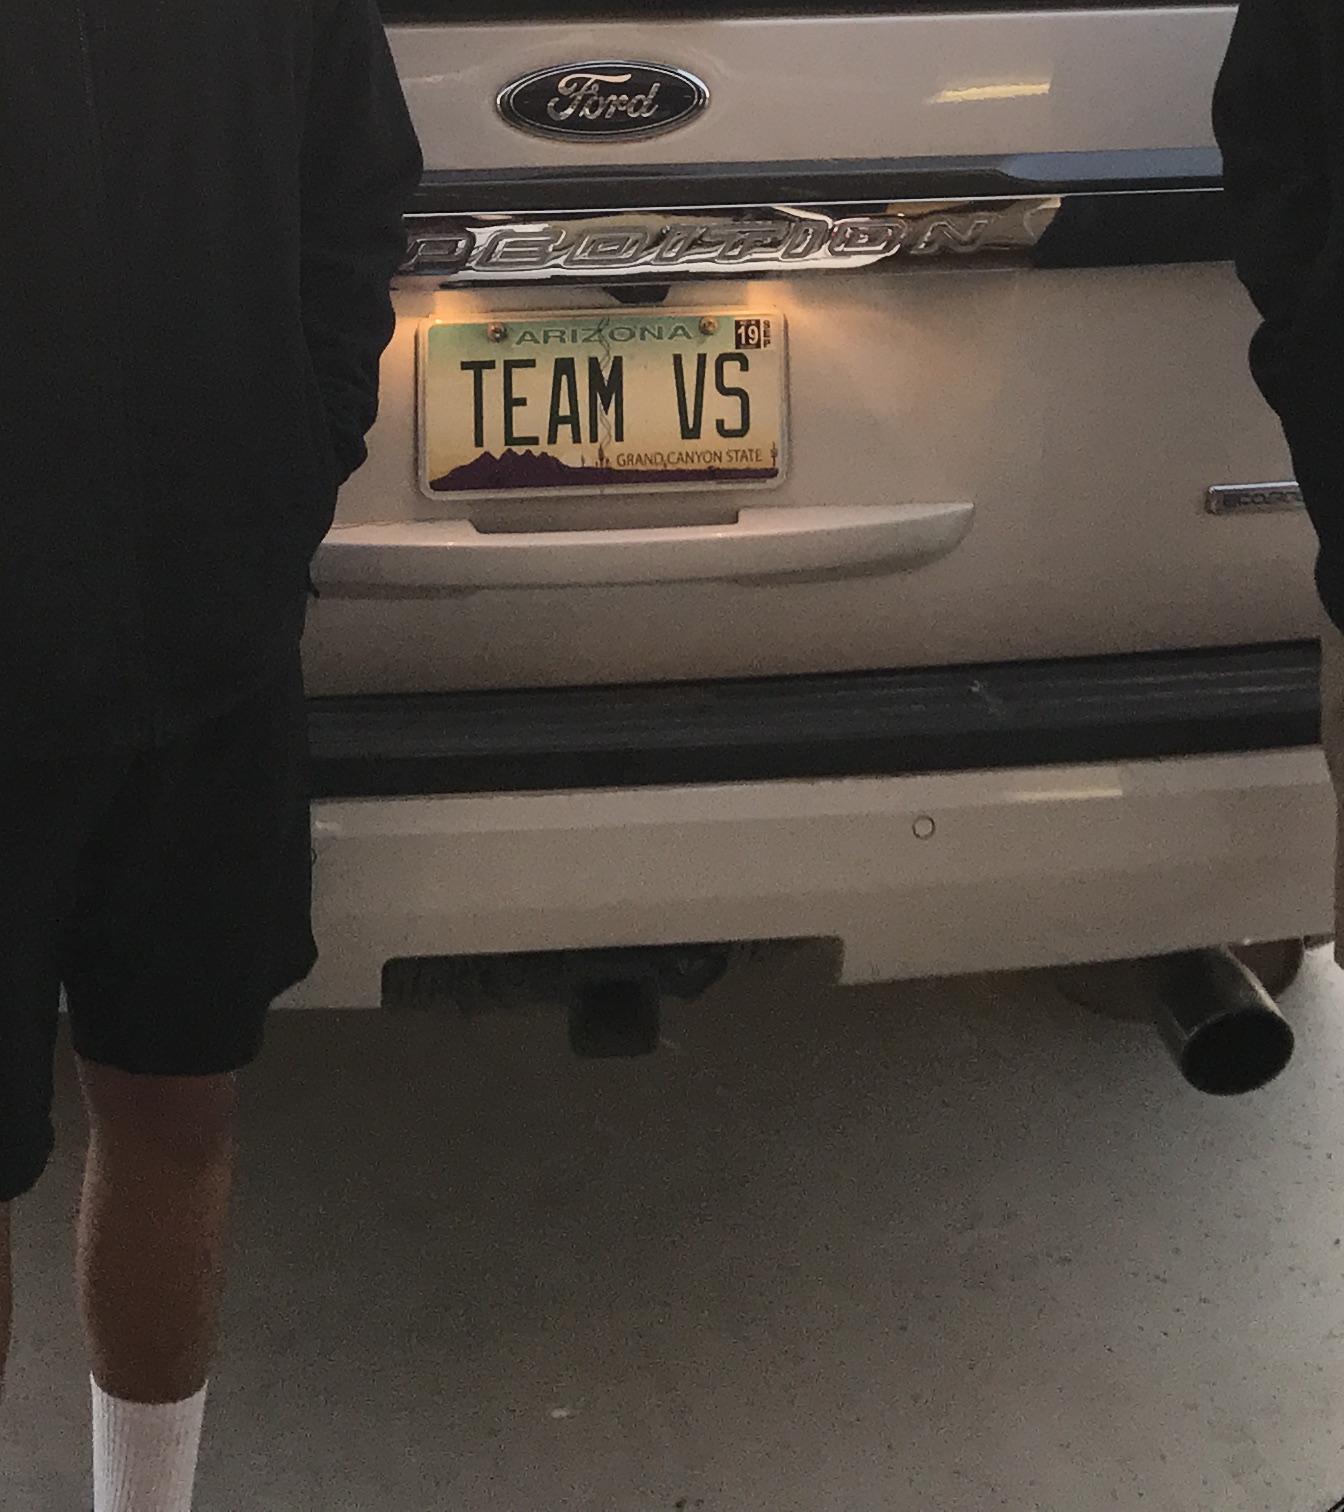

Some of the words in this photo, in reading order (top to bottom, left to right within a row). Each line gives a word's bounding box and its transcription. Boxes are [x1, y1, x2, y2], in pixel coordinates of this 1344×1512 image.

[546, 73, 661, 121] Ford
[515, 324, 694, 346] ARIZONA
[737, 325, 759, 345] 19
[763, 319, 771, 348] SEP
[460, 355, 624, 448] TEAM
[672, 352, 750, 440] VS
[616, 452, 664, 467] GRAND
[667, 449, 723, 465] CANYON
[726, 448, 763, 463] STATE
